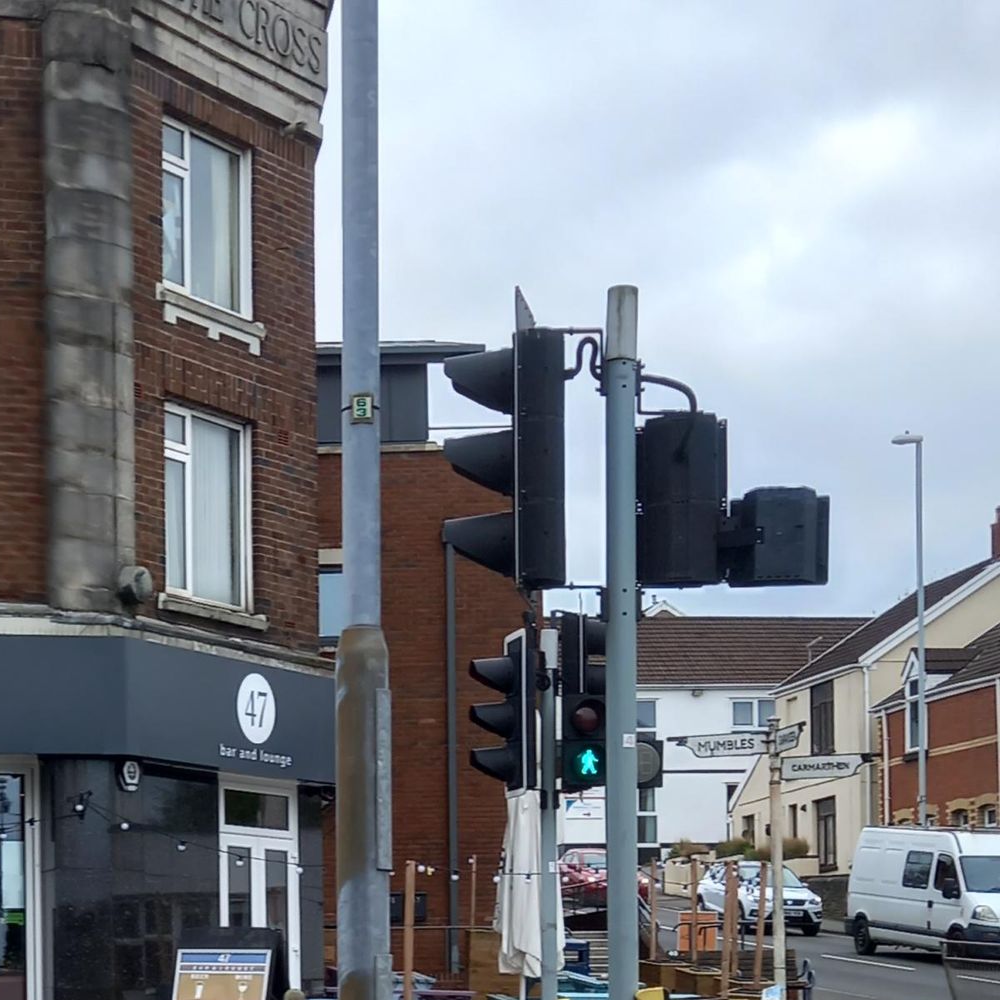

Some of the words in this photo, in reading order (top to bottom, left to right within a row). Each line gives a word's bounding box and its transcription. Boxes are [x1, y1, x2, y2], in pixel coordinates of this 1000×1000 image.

[238, 0, 322, 74] CROSS
[244, 690, 268, 728] 47
[219, 743, 236, 757] bar
[239, 748, 258, 760] and
[259, 749, 292, 768] lounge
[697, 738, 755, 752] MUMBLES
[791, 761, 850, 772] CARMARTHEN
